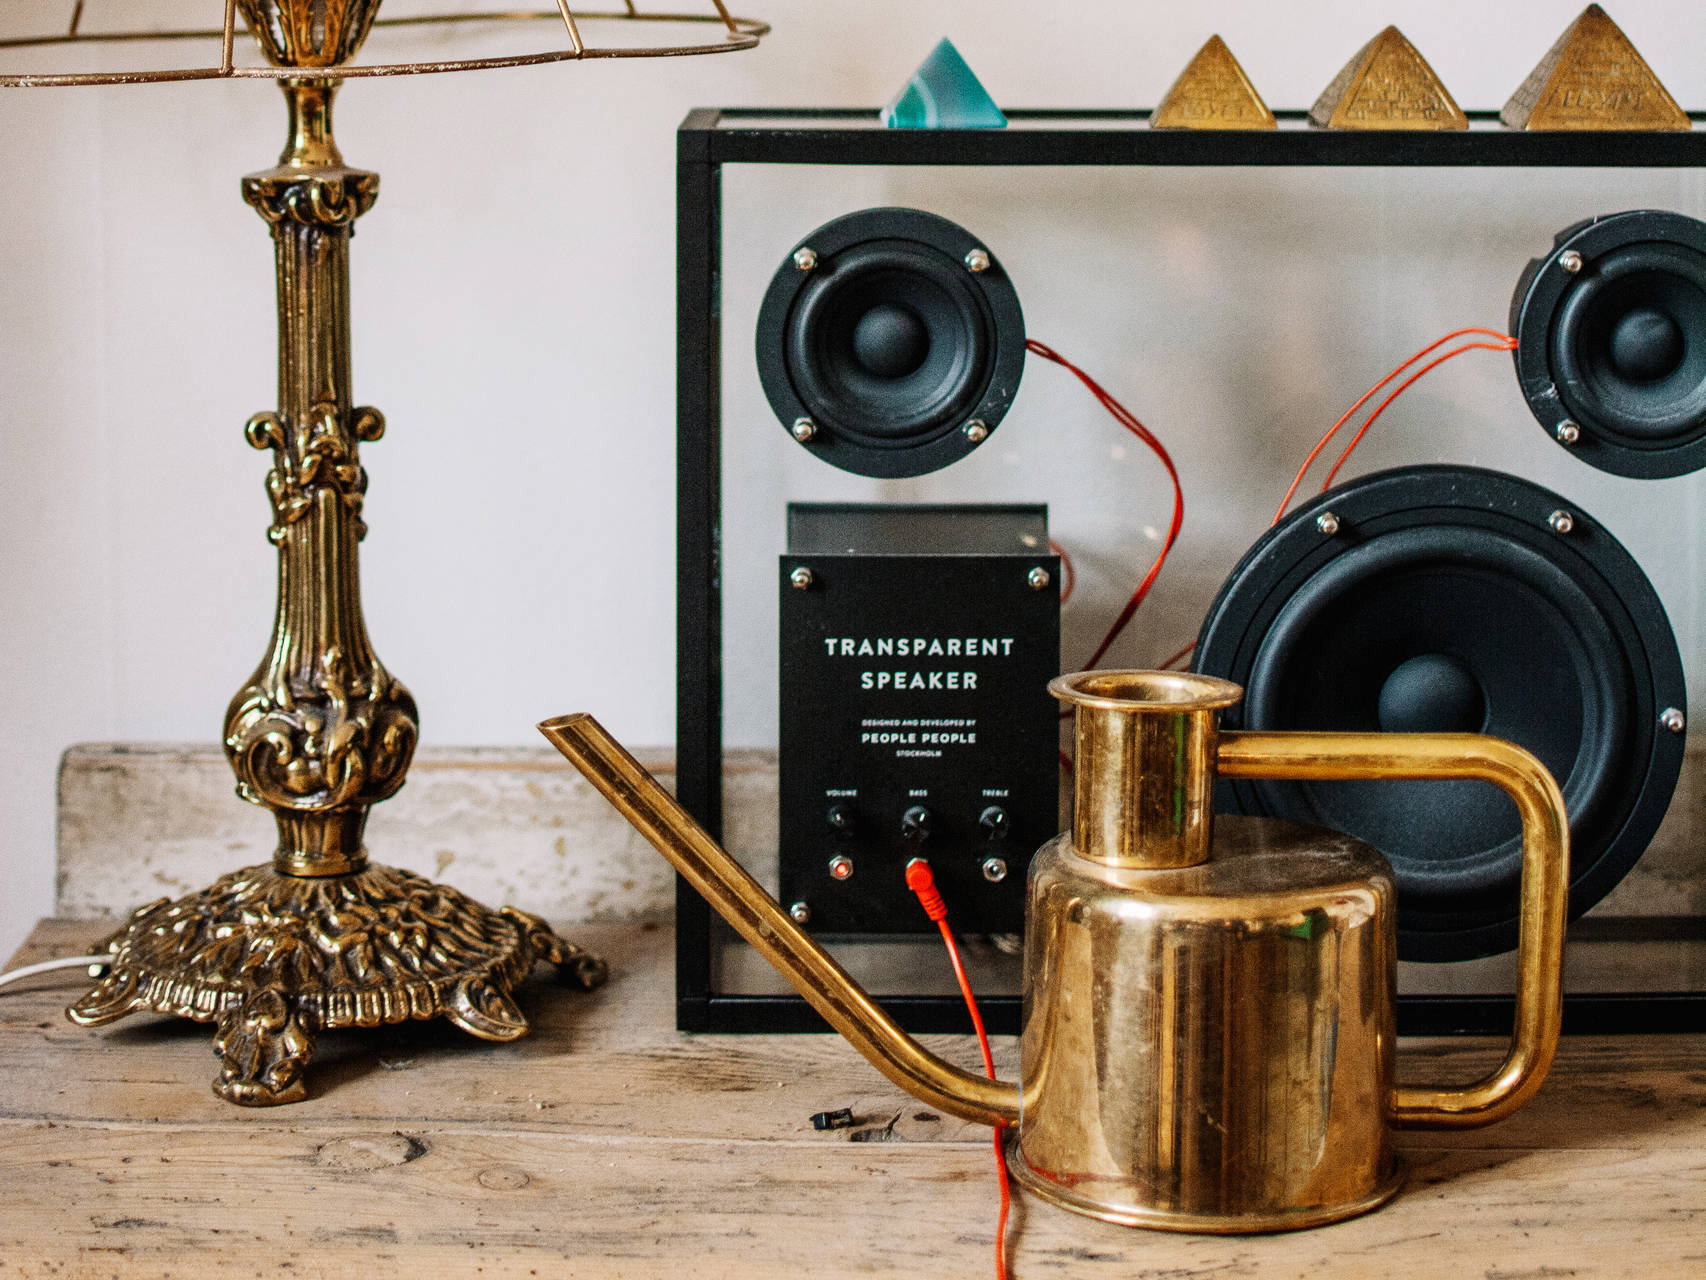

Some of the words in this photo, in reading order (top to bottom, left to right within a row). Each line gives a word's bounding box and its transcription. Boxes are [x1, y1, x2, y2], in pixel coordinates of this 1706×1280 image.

[825, 638, 1014, 656] TRANSPARENT
[861, 672, 978, 689] SPEAKER
[861, 719, 900, 727] DESIGNED
[901, 719, 918, 727] AND
[920, 719, 965, 727] DEVELOPED
[966, 719, 976, 727] BY
[861, 733, 916, 744] PEOPLE
[922, 733, 976, 744] PEOPLE
[826, 789, 857, 797] VOLUME
[909, 789, 928, 797] BASS
[982, 789, 1009, 797] TREBLE
